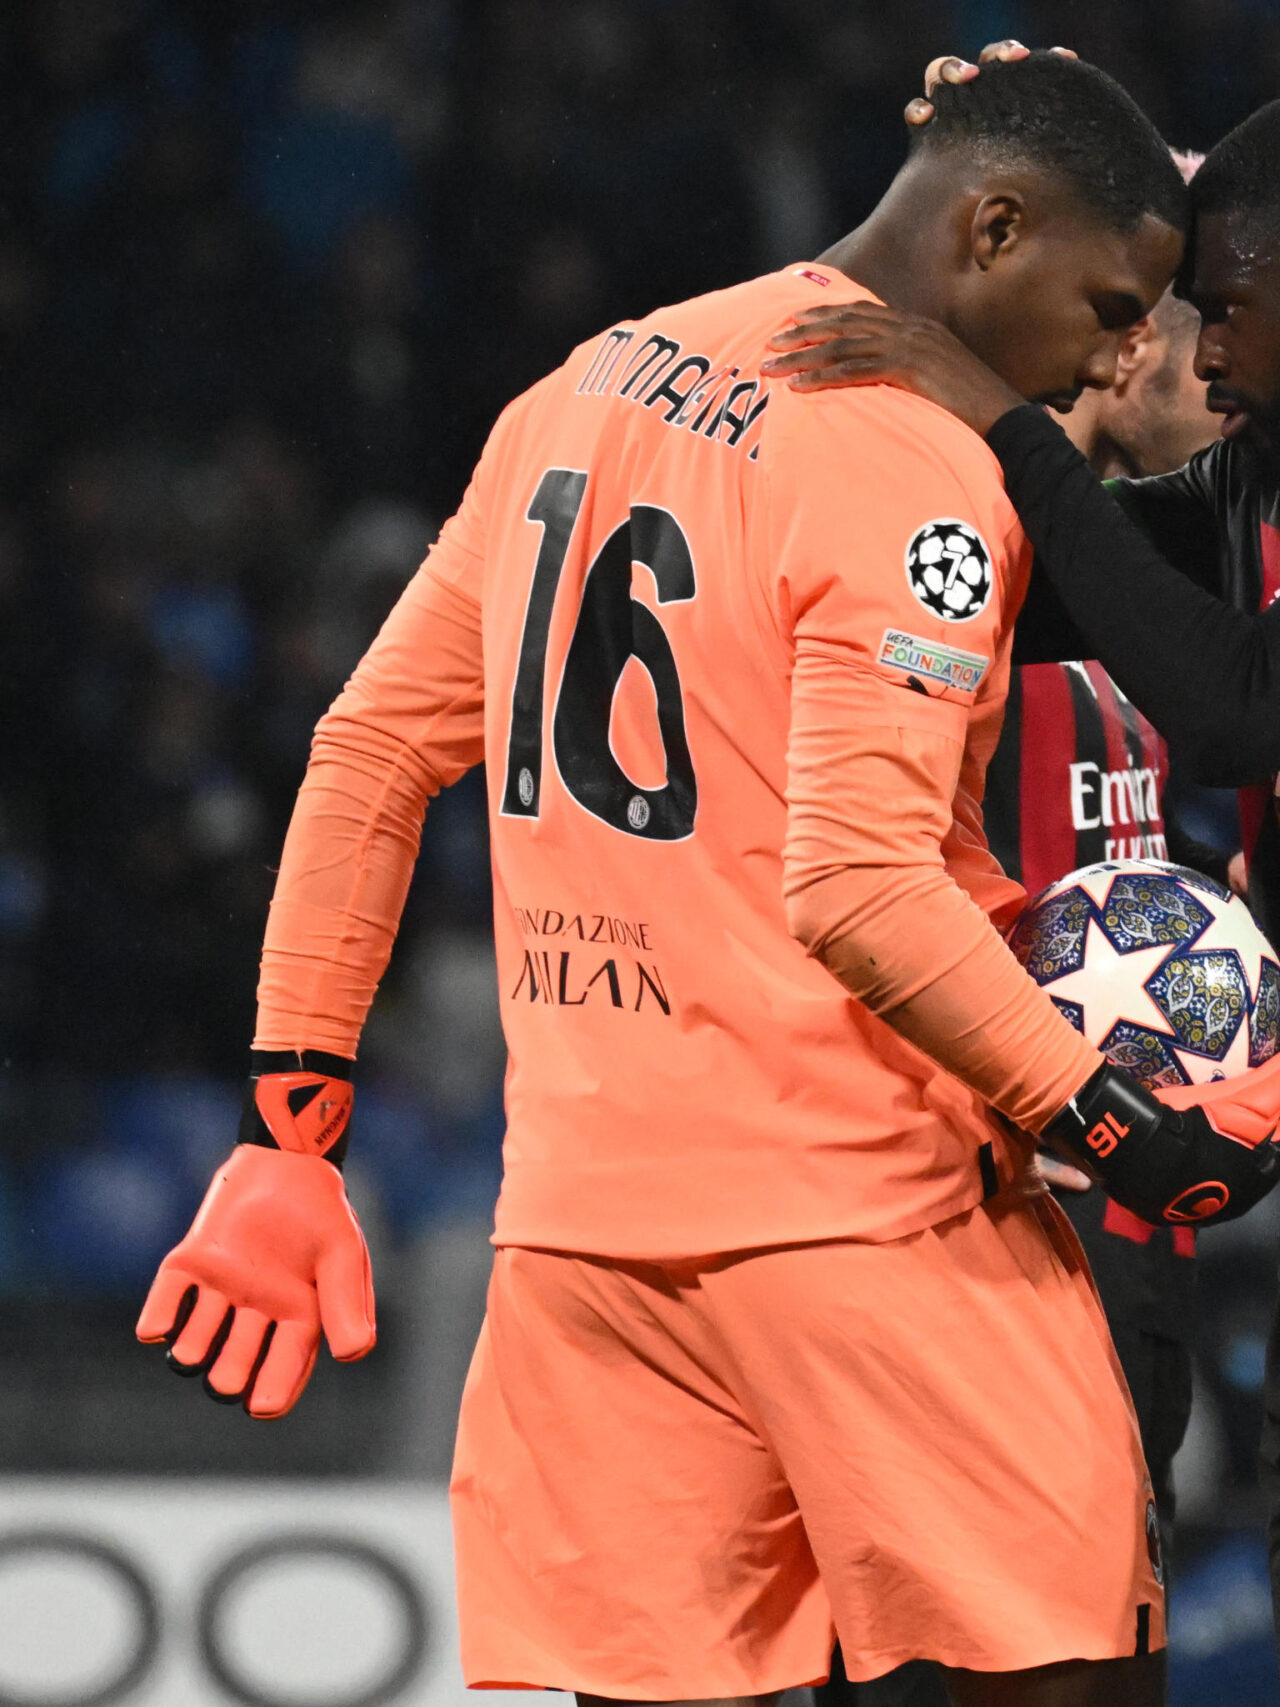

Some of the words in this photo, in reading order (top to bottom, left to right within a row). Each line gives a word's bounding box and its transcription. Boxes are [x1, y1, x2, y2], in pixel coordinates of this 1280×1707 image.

[941, 549, 965, 591] 7
[499, 468, 698, 842] 16
[886, 631, 915, 648] UEFA
[880, 643, 984, 684] FOUNDATION
[511, 949, 672, 1016] MILAN
[1085, 1111, 1130, 1158] 16
